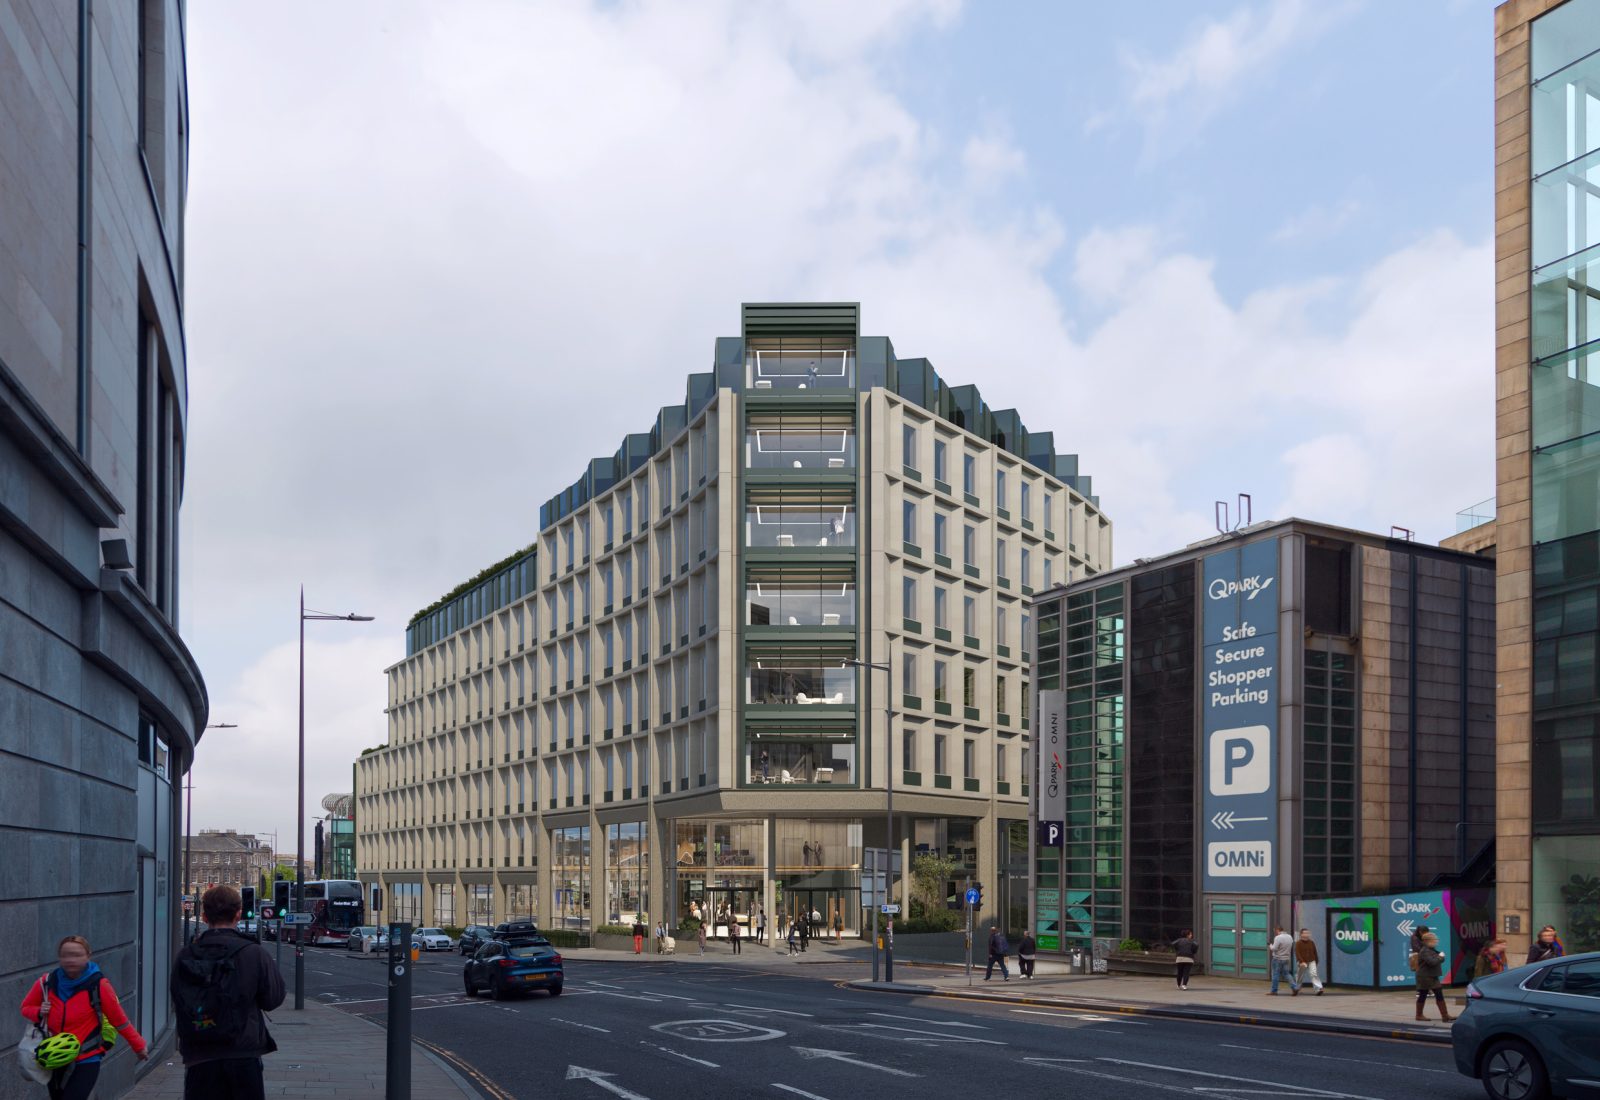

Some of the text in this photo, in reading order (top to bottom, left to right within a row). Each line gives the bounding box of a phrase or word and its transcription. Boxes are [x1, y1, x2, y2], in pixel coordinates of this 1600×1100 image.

[1222, 621, 1257, 642] Safe
[1215, 646, 1265, 665] Secure
[1208, 666, 1273, 687] Shopper
[1211, 688, 1269, 707] Parking
[1224, 737, 1255, 786] P
[1049, 825, 1059, 845] P
